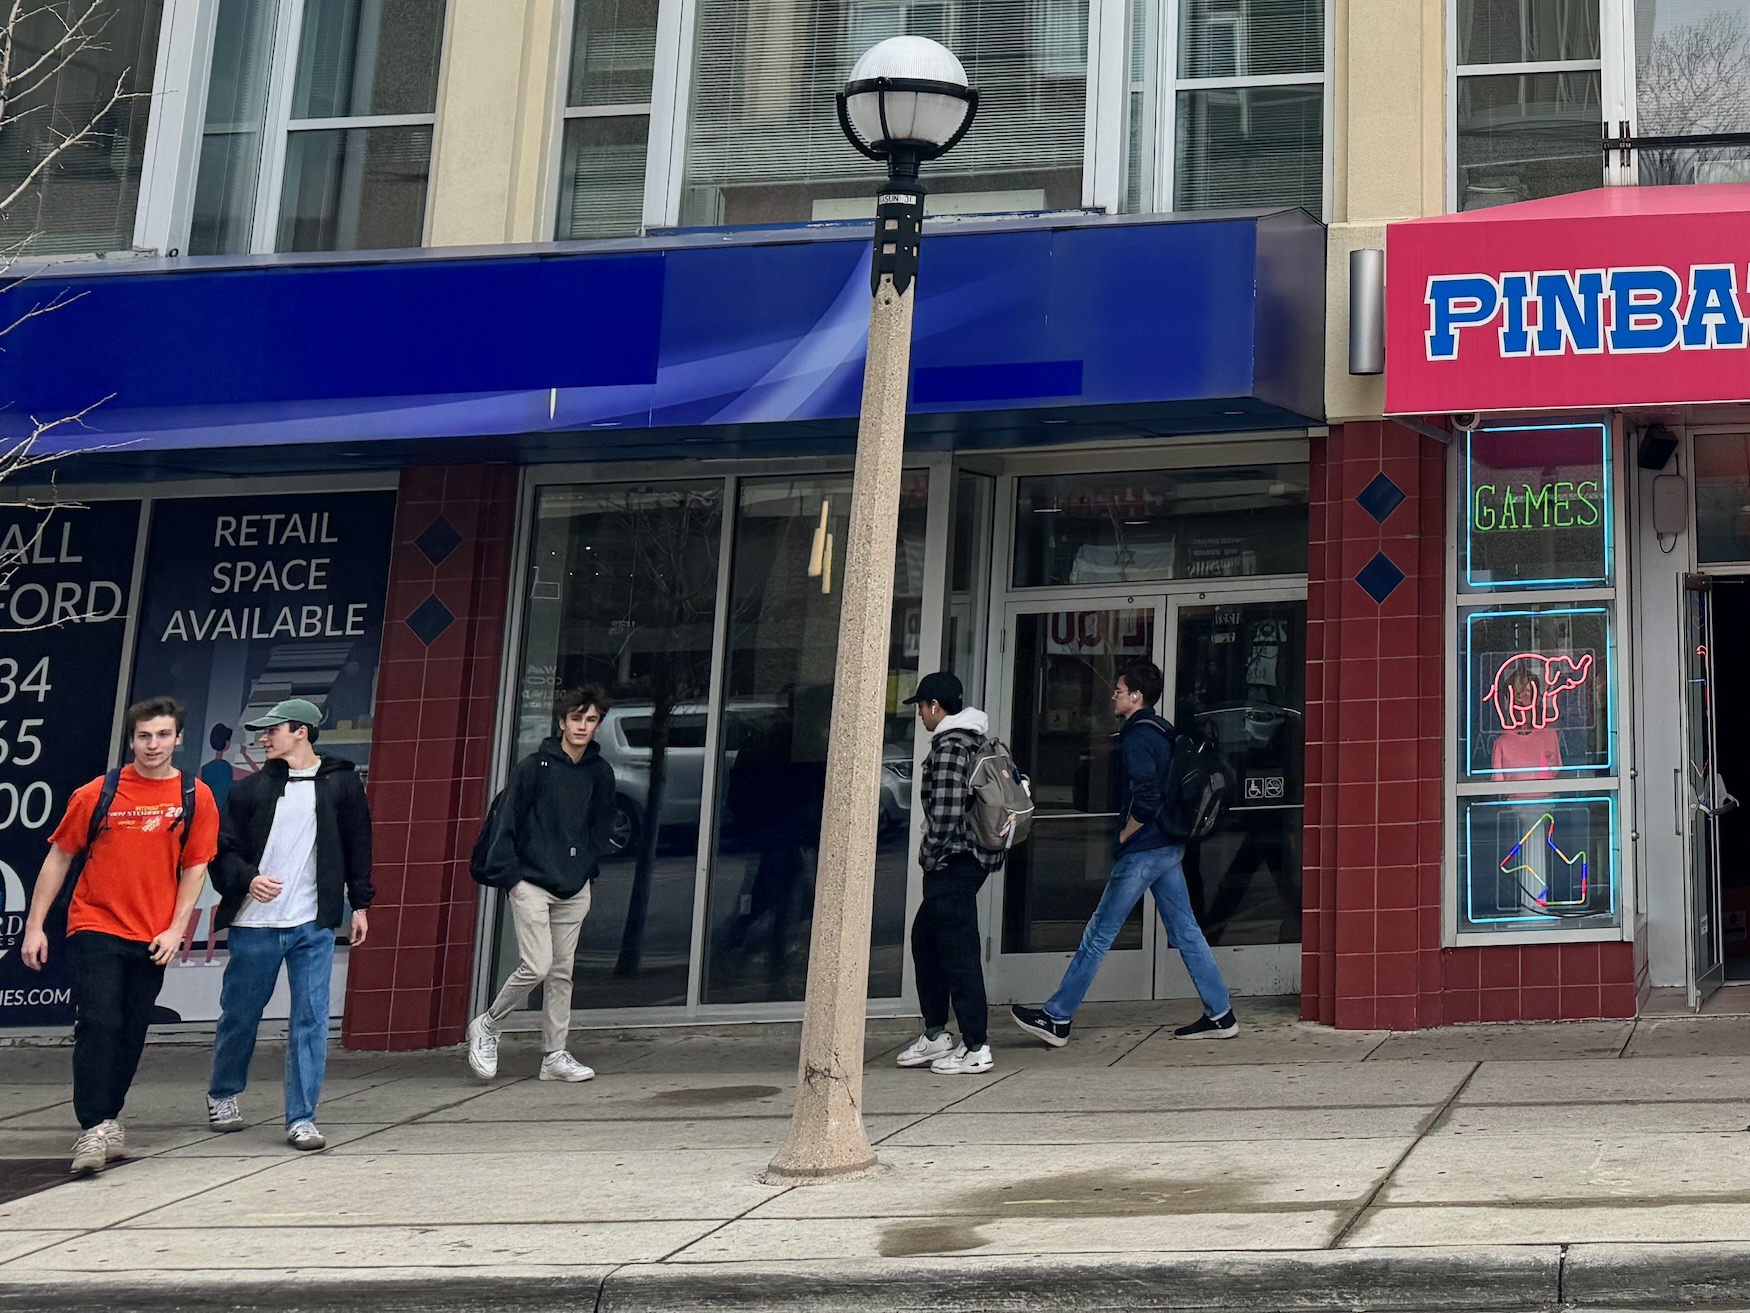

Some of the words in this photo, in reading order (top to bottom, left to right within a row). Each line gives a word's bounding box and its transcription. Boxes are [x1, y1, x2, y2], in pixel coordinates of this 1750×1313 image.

[1475, 481, 1599, 530] GAMES
[214, 512, 338, 547] RETAIL
[210, 558, 331, 594] SPACE
[160, 603, 368, 642] AVAILABLE
[165, 806, 183, 817] 20
